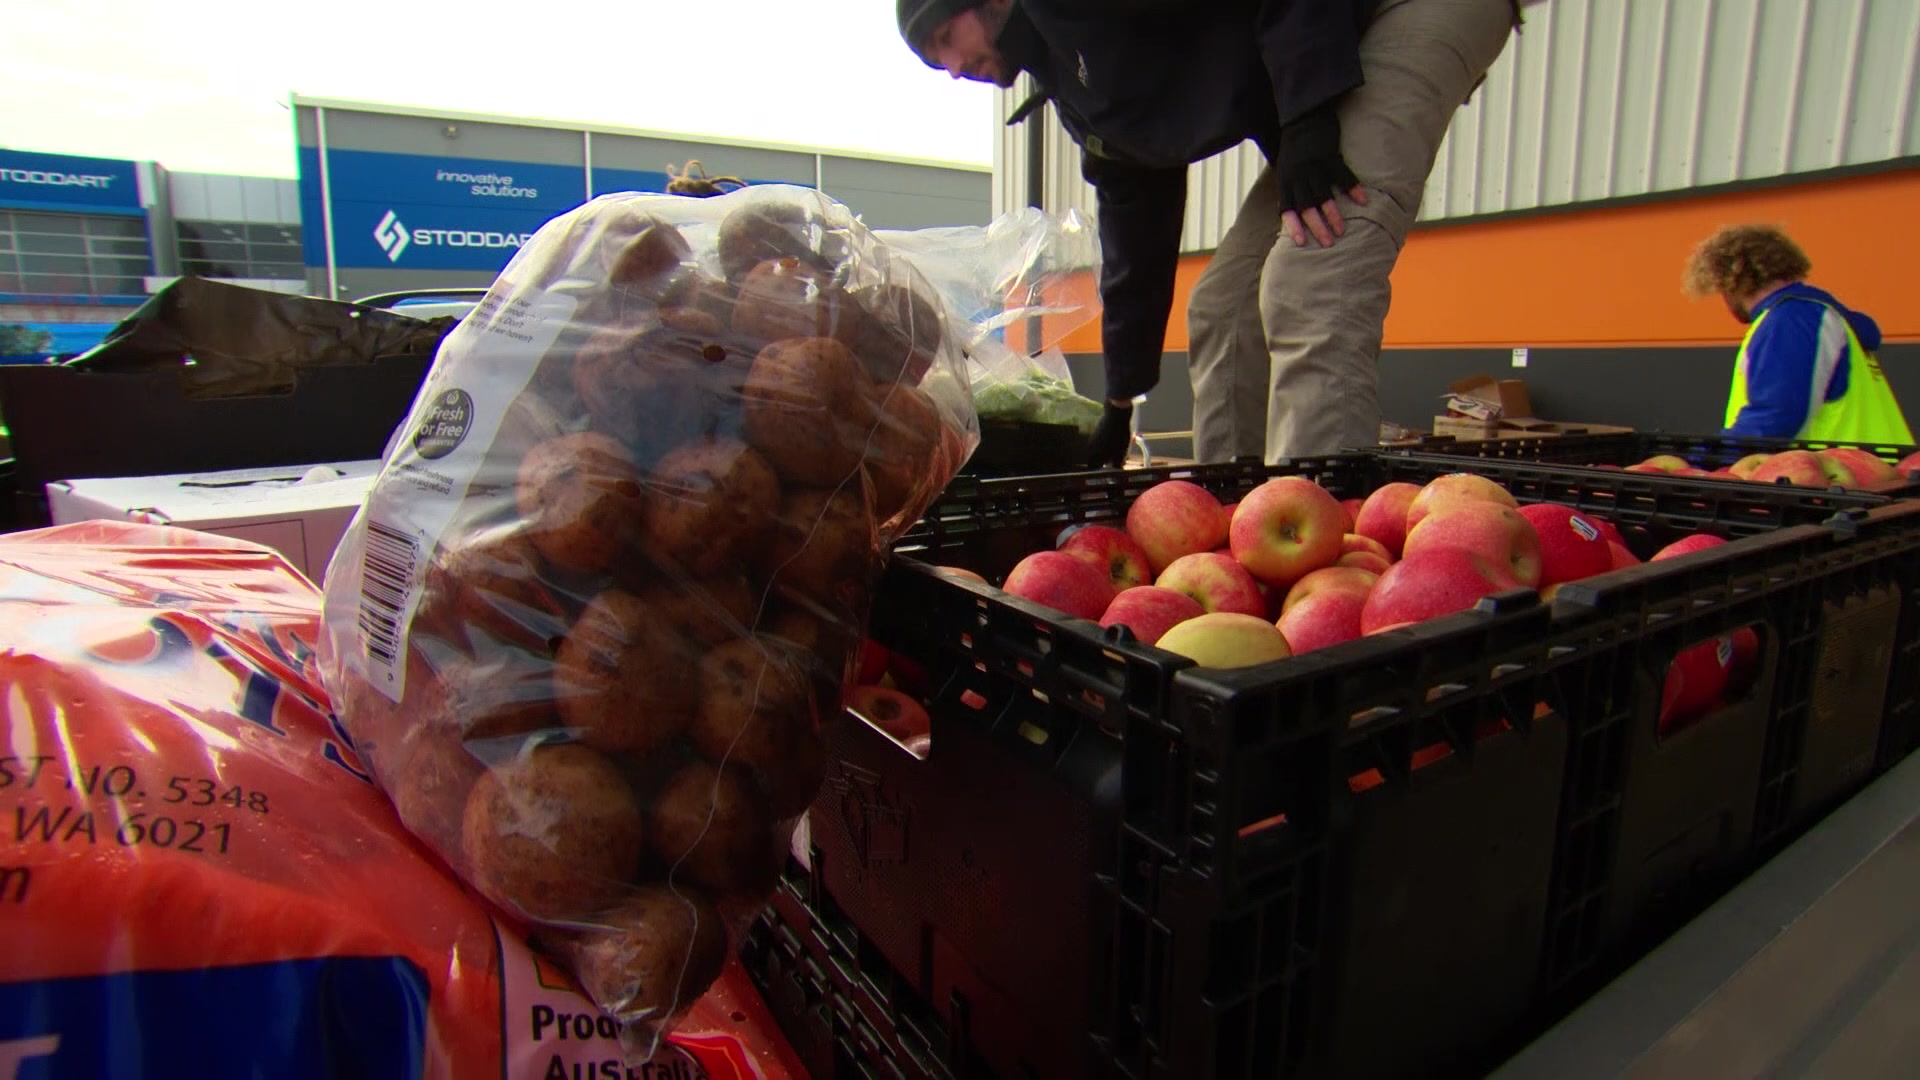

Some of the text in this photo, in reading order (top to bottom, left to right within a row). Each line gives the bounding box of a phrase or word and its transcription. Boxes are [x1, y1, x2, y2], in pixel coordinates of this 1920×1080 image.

[436, 169, 513, 185] innovative
[471, 184, 537, 198] solutions
[431, 405, 464, 421] Fresh
[420, 421, 463, 437] or Free
[387, 672, 394, 682] 9
[66, 765, 146, 797] NO.
[163, 775, 270, 815] 5348
[15, 806, 232, 854] WA 6021
